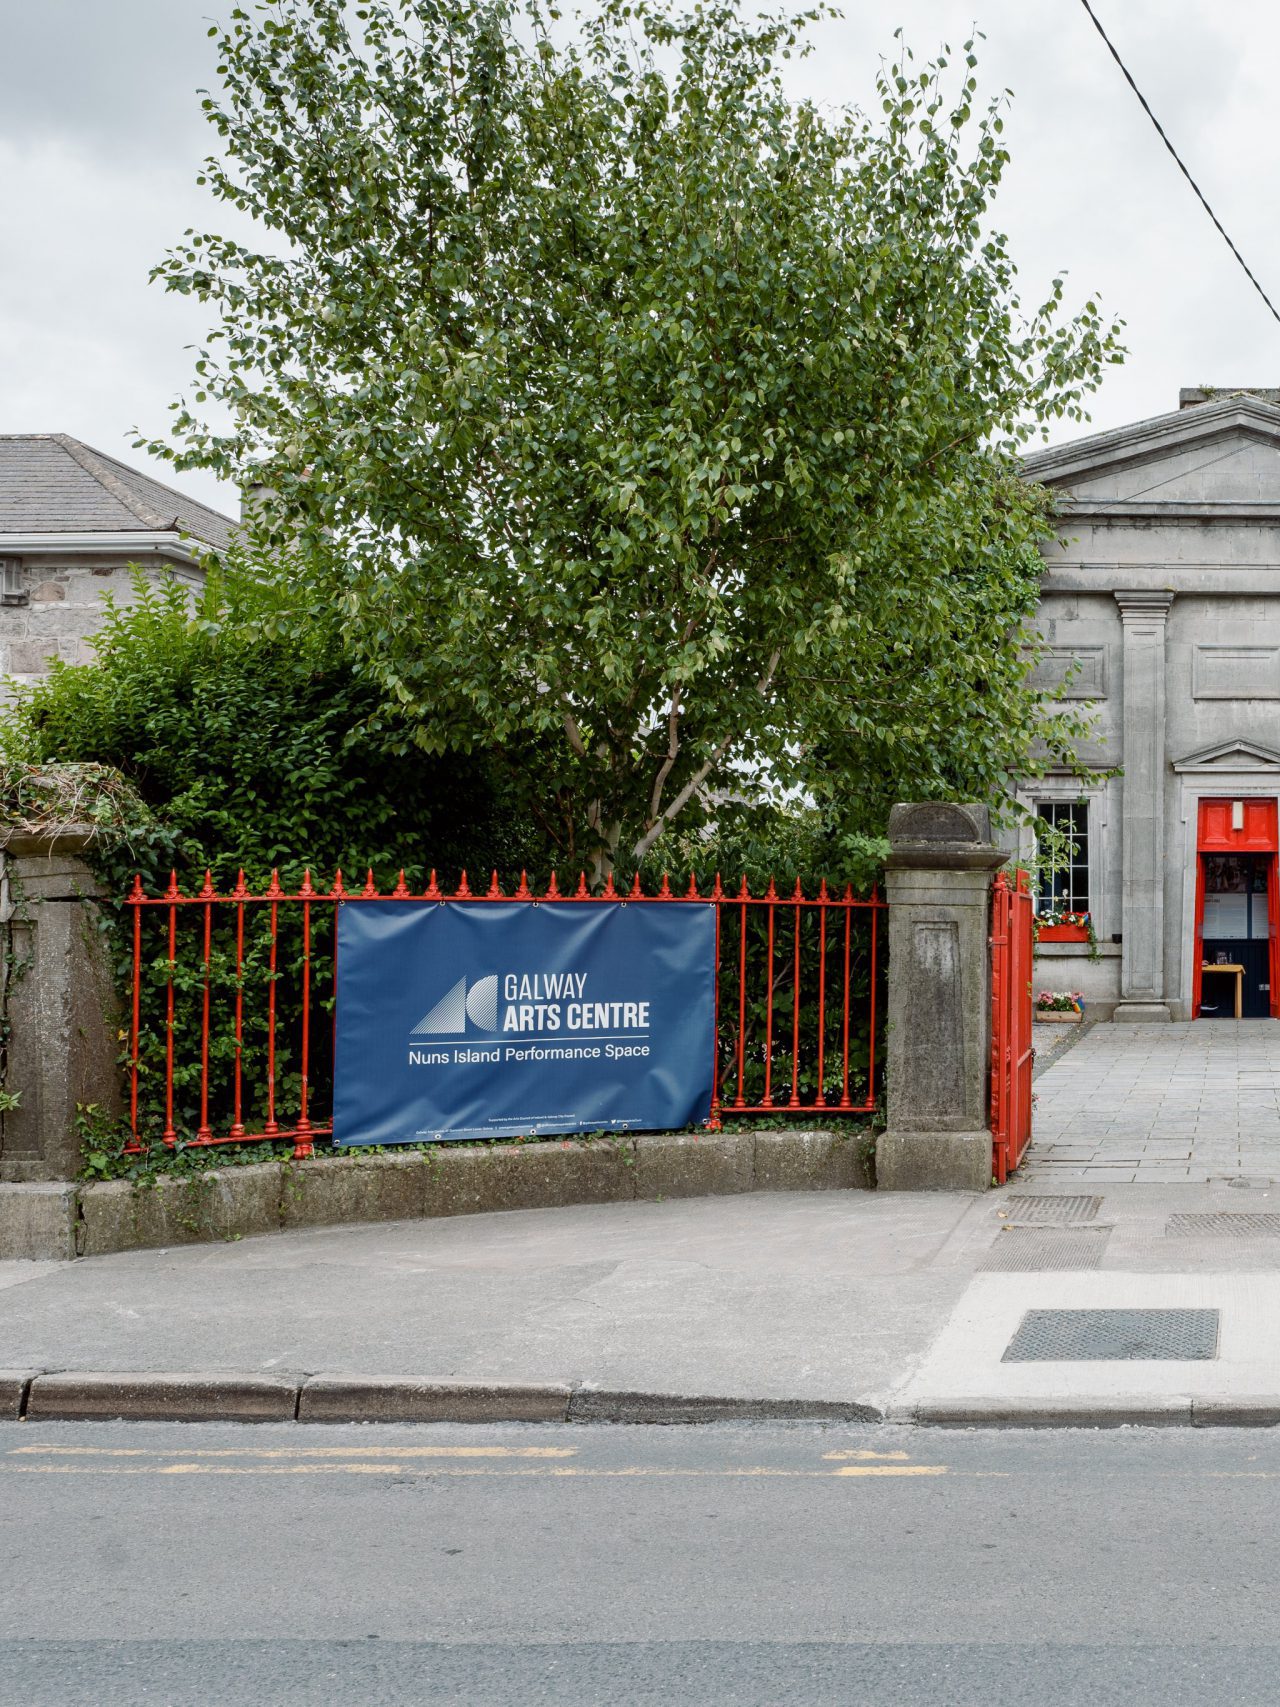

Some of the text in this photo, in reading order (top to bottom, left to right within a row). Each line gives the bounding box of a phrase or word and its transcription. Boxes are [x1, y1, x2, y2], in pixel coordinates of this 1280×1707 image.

[504, 973, 587, 1000] GALWAY
[503, 1002, 650, 1032] ARTS CENTRE
[409, 1044, 650, 1065] Nuns Island Performance Space
